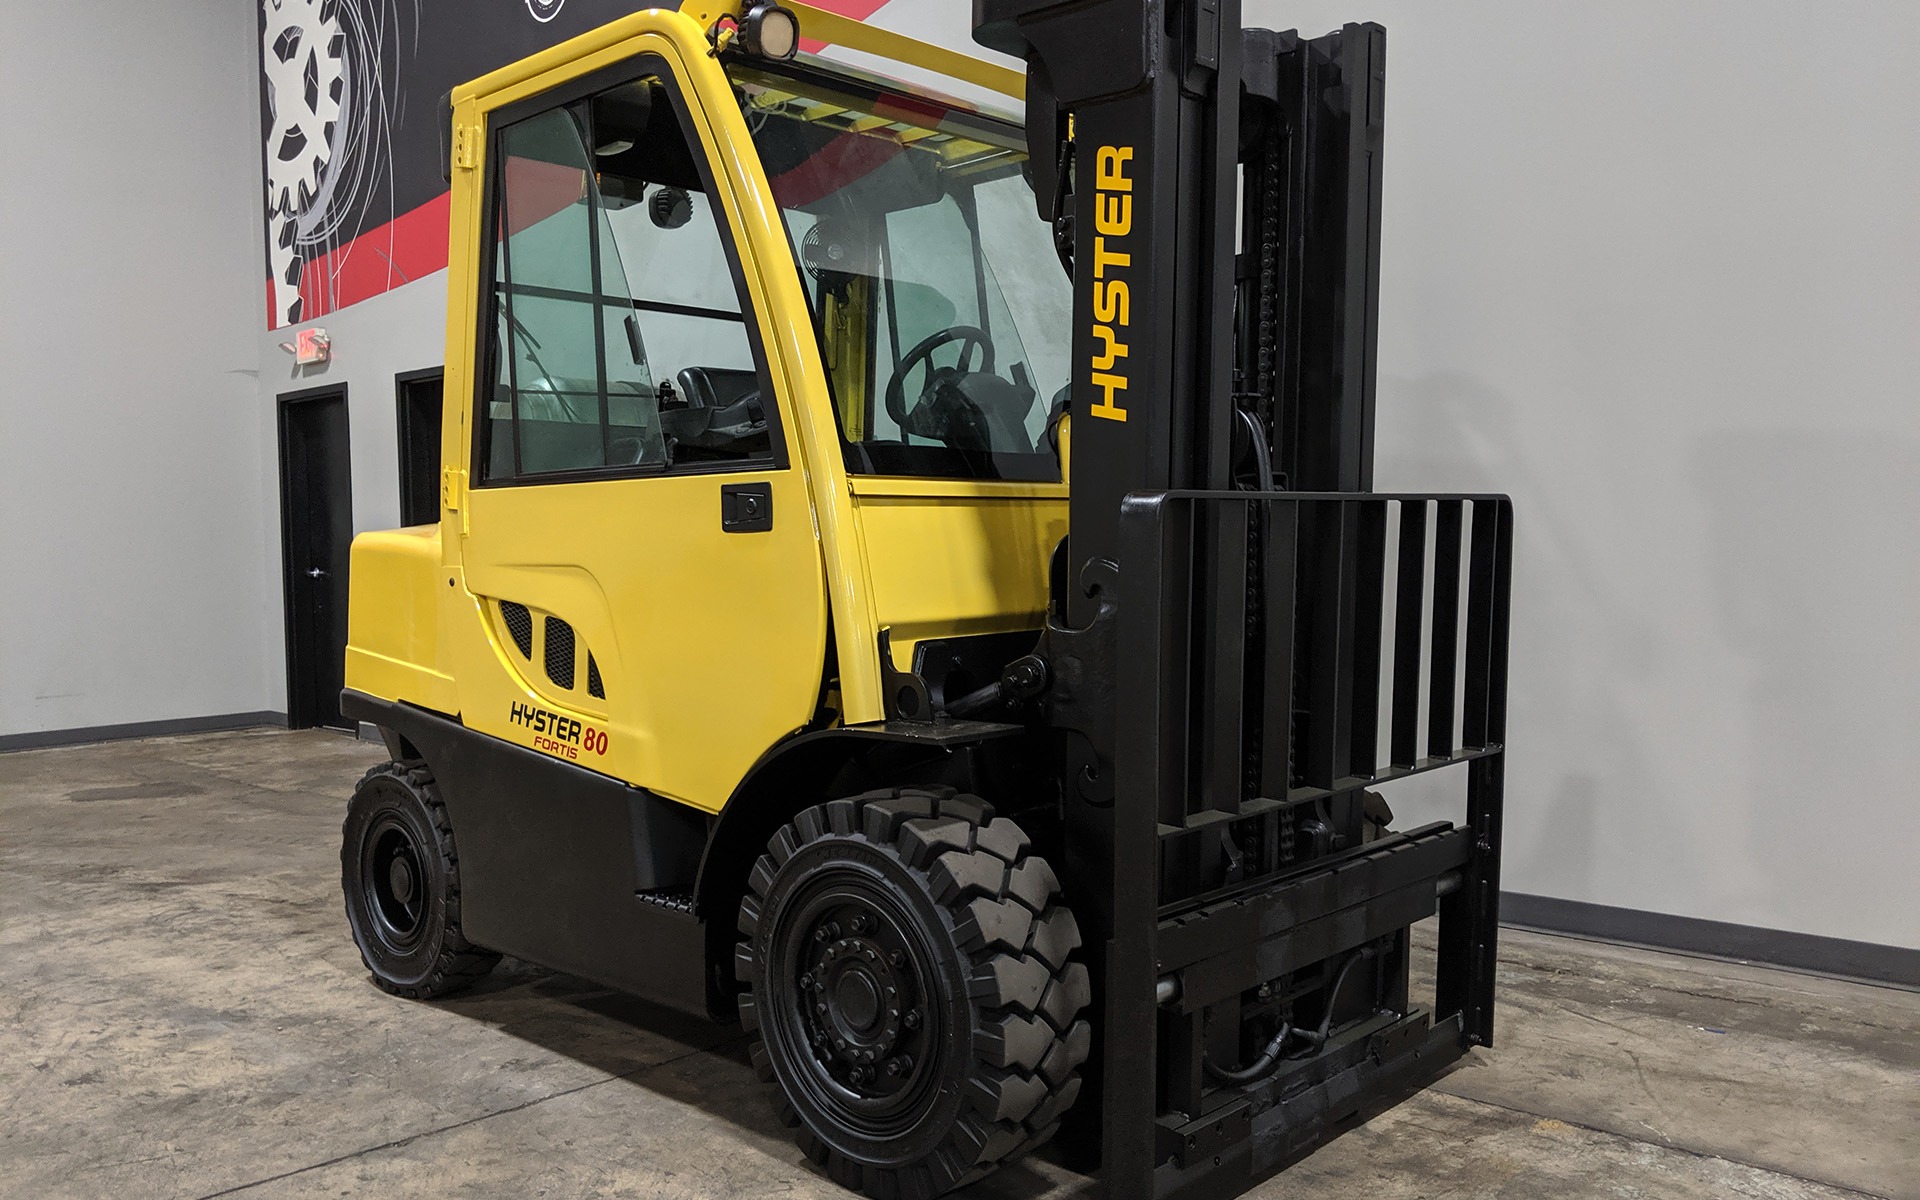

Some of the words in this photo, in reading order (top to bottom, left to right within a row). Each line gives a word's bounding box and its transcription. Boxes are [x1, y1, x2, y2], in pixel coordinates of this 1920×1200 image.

[1090, 145, 1133, 422] HYSTER
[510, 701, 581, 745] HYSTER
[583, 727, 608, 756] 80
[534, 736, 578, 759] FORTIS
